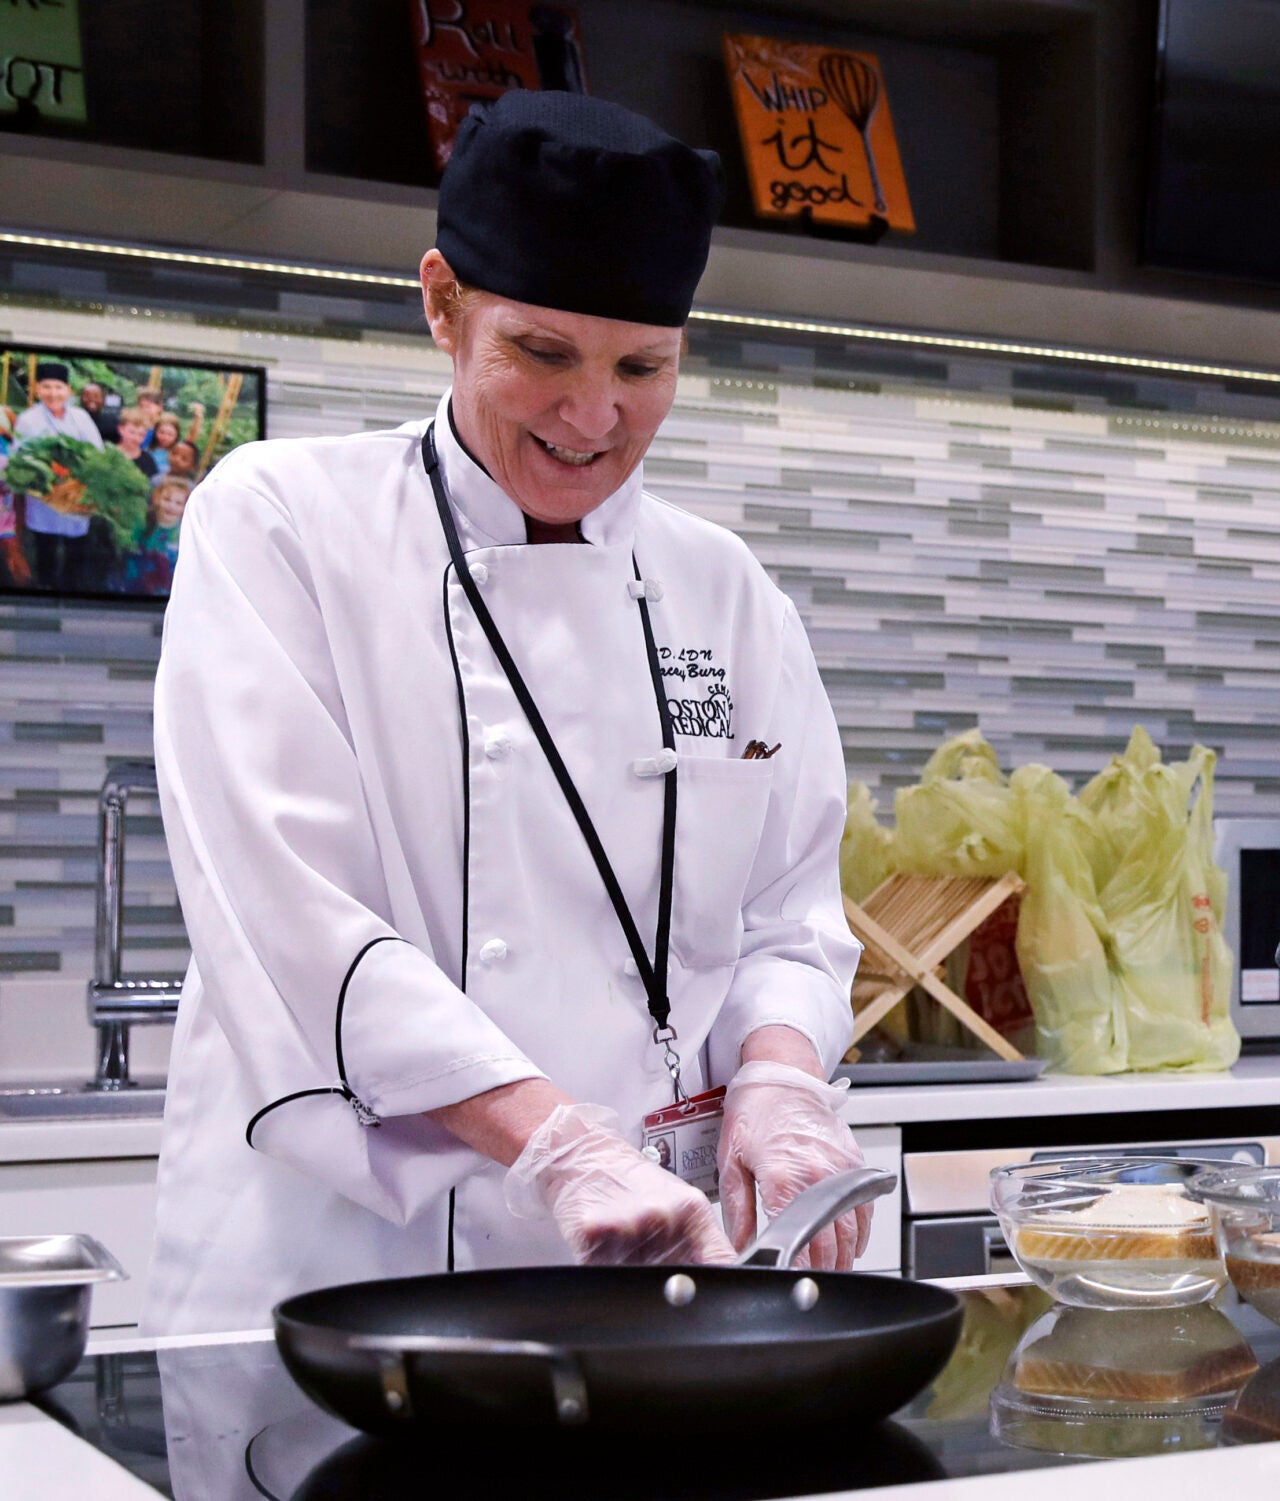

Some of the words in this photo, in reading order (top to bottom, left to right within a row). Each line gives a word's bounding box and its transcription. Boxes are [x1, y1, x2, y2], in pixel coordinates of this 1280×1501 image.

[419, 0, 526, 60] Roll
[0, 57, 82, 105] OT
[740, 69, 829, 114] WHIP
[762, 116, 843, 175] it
[771, 174, 863, 209] good
[659, 666, 686, 683] acey
[686, 663, 726, 682] Burg
[667, 698, 728, 721] OSTON
